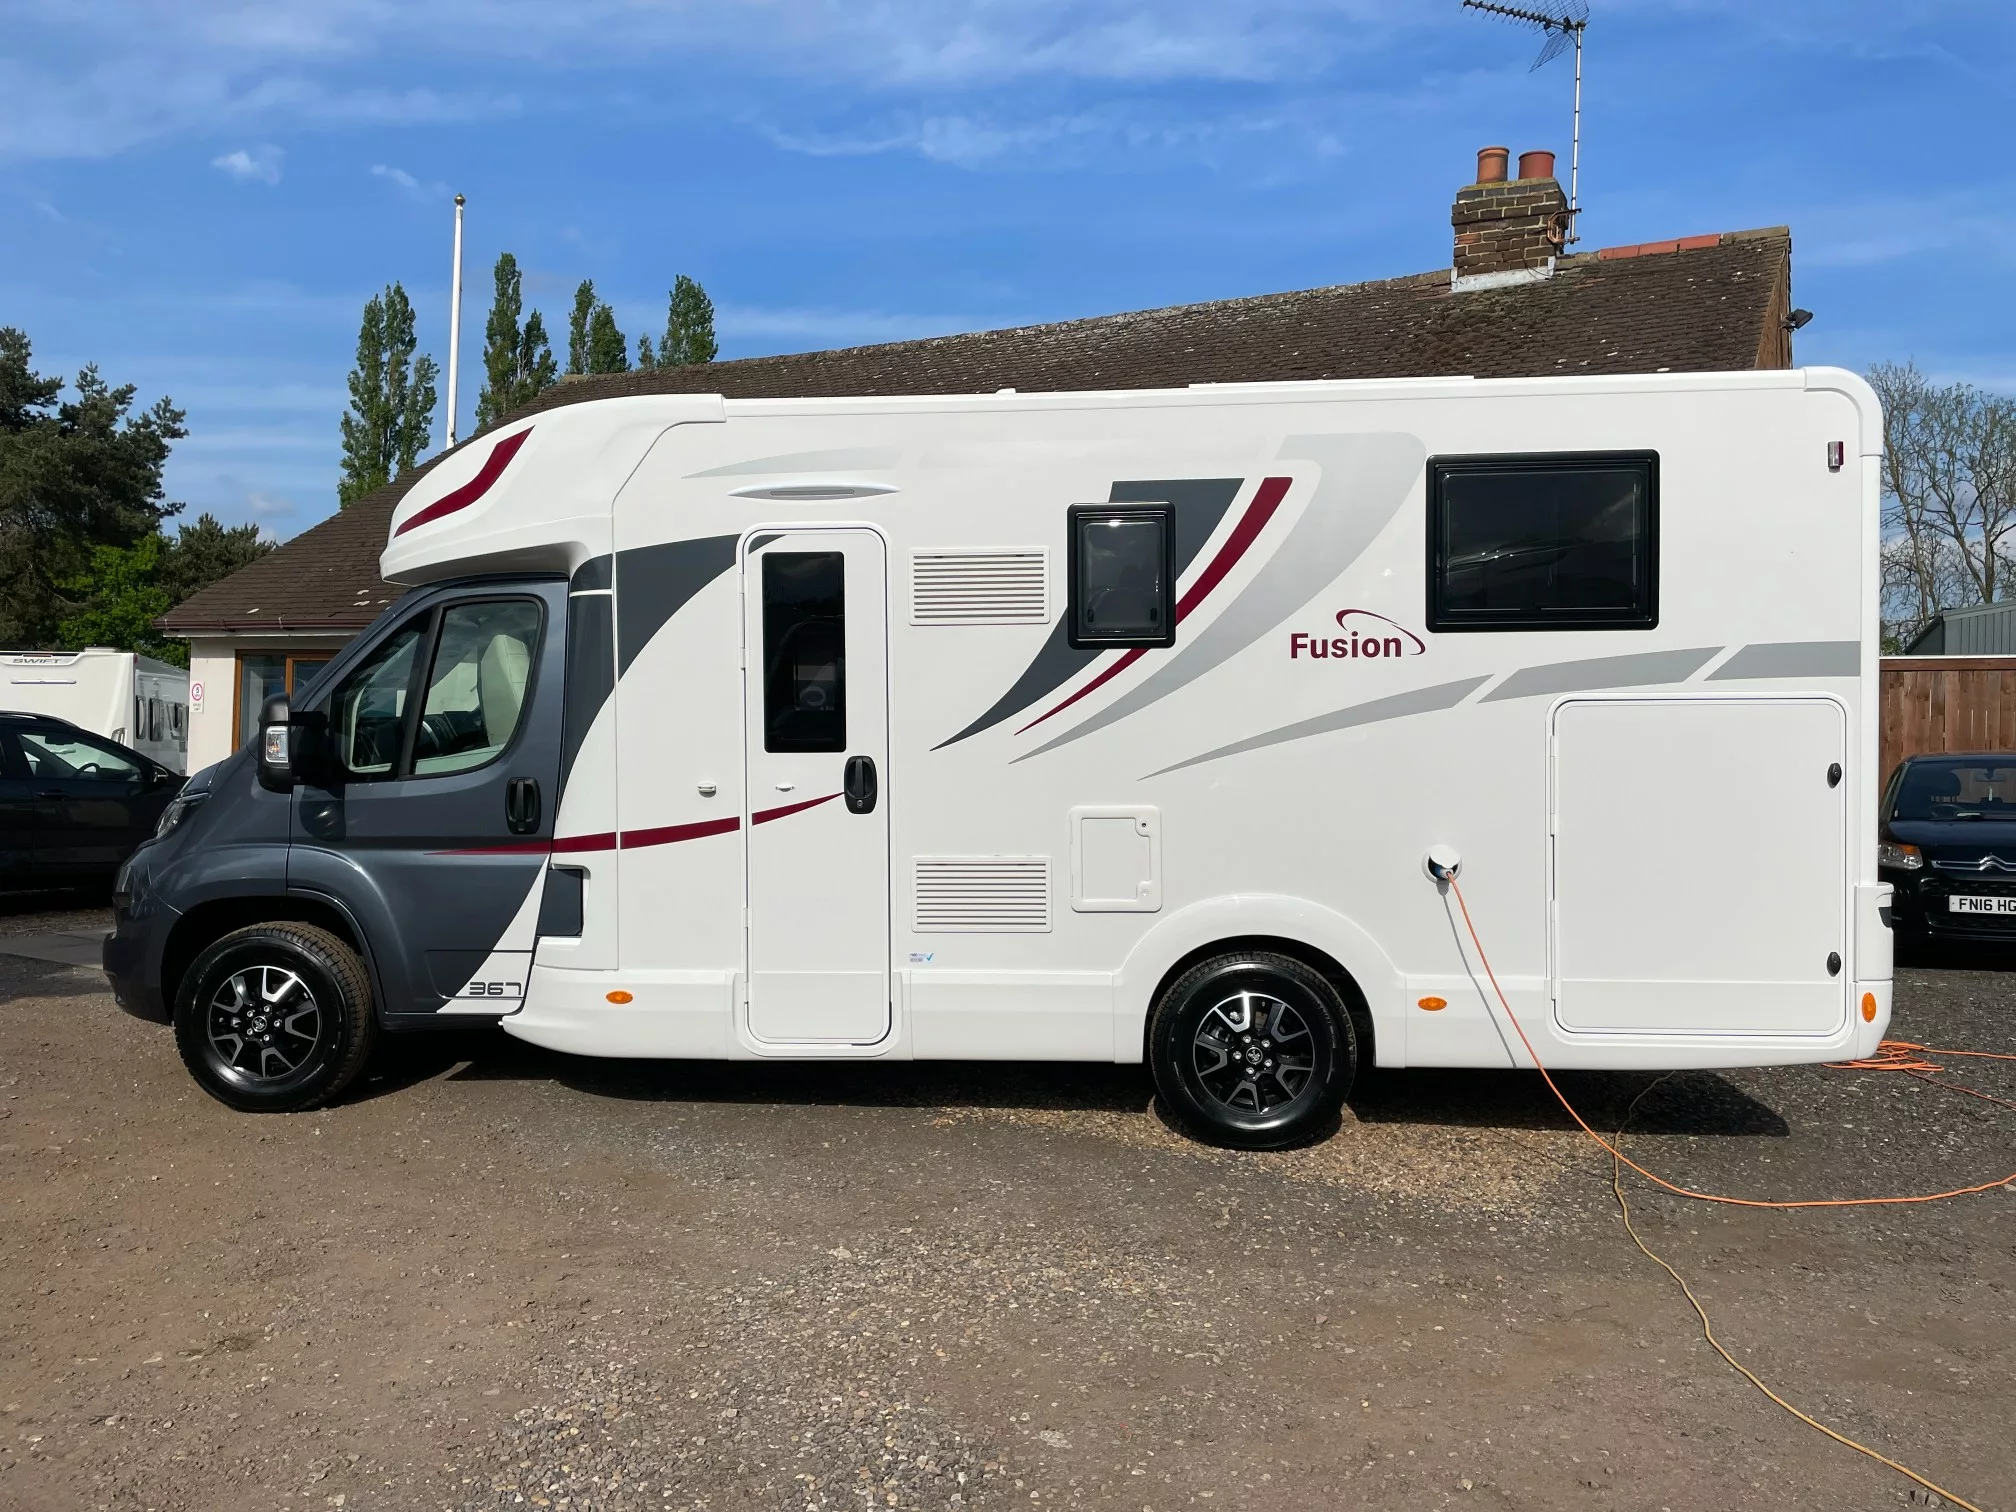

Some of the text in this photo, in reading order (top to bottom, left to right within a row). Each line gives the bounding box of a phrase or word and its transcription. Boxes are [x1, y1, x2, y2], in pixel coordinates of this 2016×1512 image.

[1290, 631, 1402, 659] Fusion
[1959, 898, 1993, 911] FN16
[469, 982, 522, 996] 367
